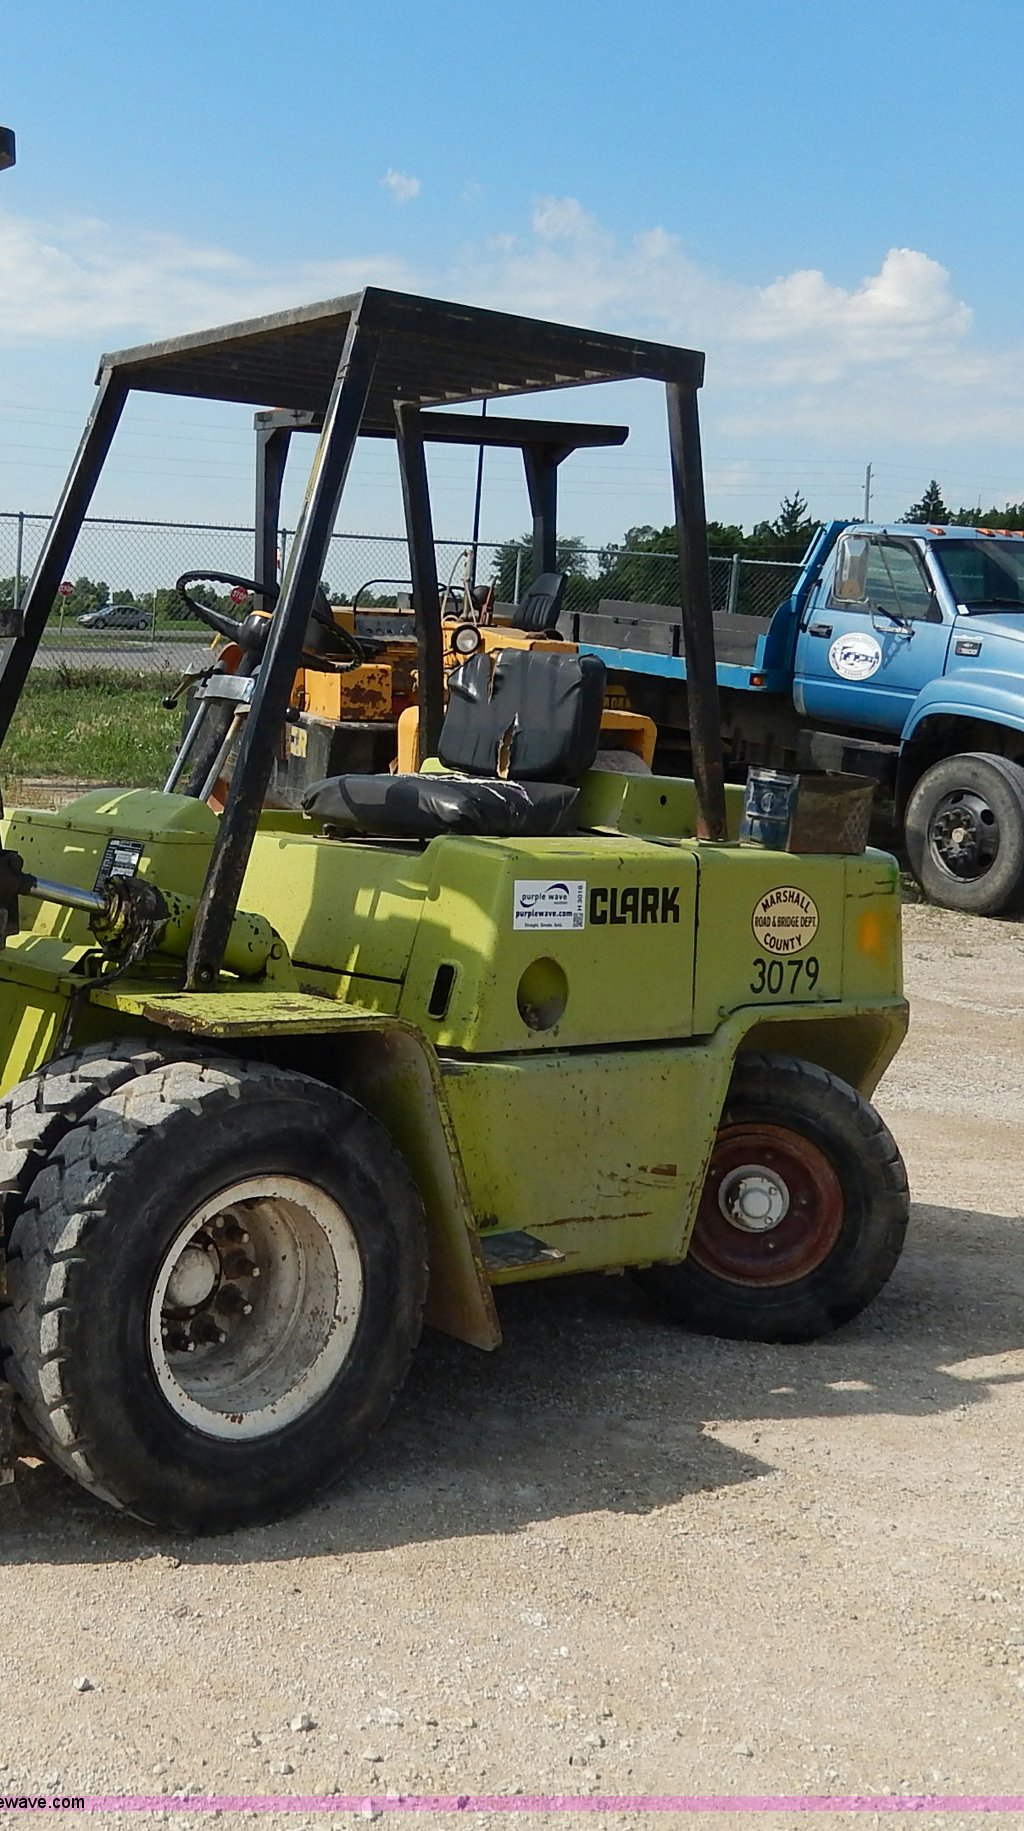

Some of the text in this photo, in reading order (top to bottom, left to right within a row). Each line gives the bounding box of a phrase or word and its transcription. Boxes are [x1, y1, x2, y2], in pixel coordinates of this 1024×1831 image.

[522, 893, 546, 901] purple
[589, 887, 680, 924] CLARK
[761, 890, 811, 913] MARSHALL
[516, 909, 573, 919] purplewave.com
[755, 916, 817, 927] ROAD & BRIDGE DEPT.
[764, 933, 802, 951] COUNTY
[750, 957, 819, 994] 3079
